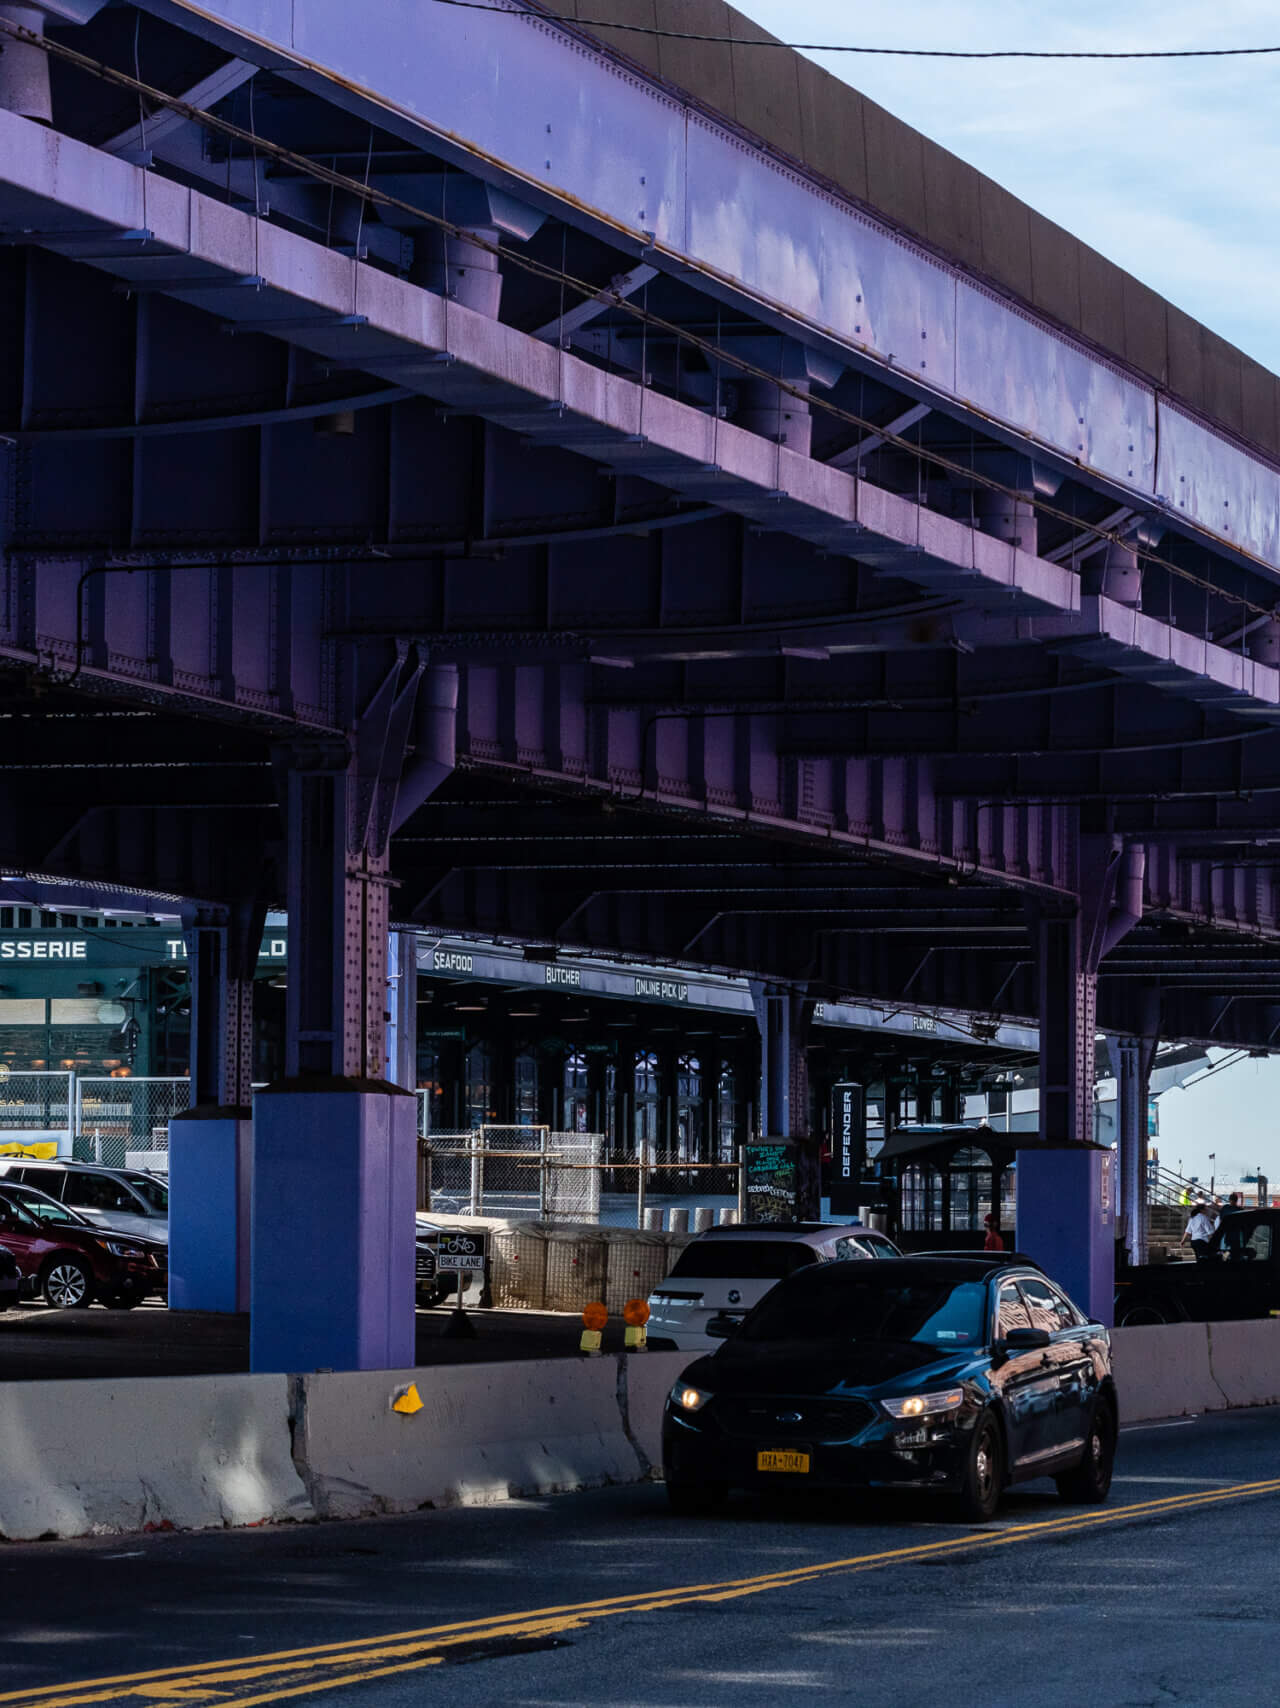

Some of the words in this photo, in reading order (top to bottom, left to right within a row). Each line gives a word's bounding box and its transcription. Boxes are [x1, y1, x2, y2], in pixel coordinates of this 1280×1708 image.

[433, 951, 473, 972] SEAFOOD
[546, 966, 581, 985] BUTCHER
[635, 978, 660, 996] ONLINE
[661, 982, 677, 998] PICK
[678, 984, 688, 1000] UP
[842, 1091, 852, 1177] DEFENDER
[441, 1256, 458, 1266] BIKE
[460, 1257, 481, 1267] LANE
